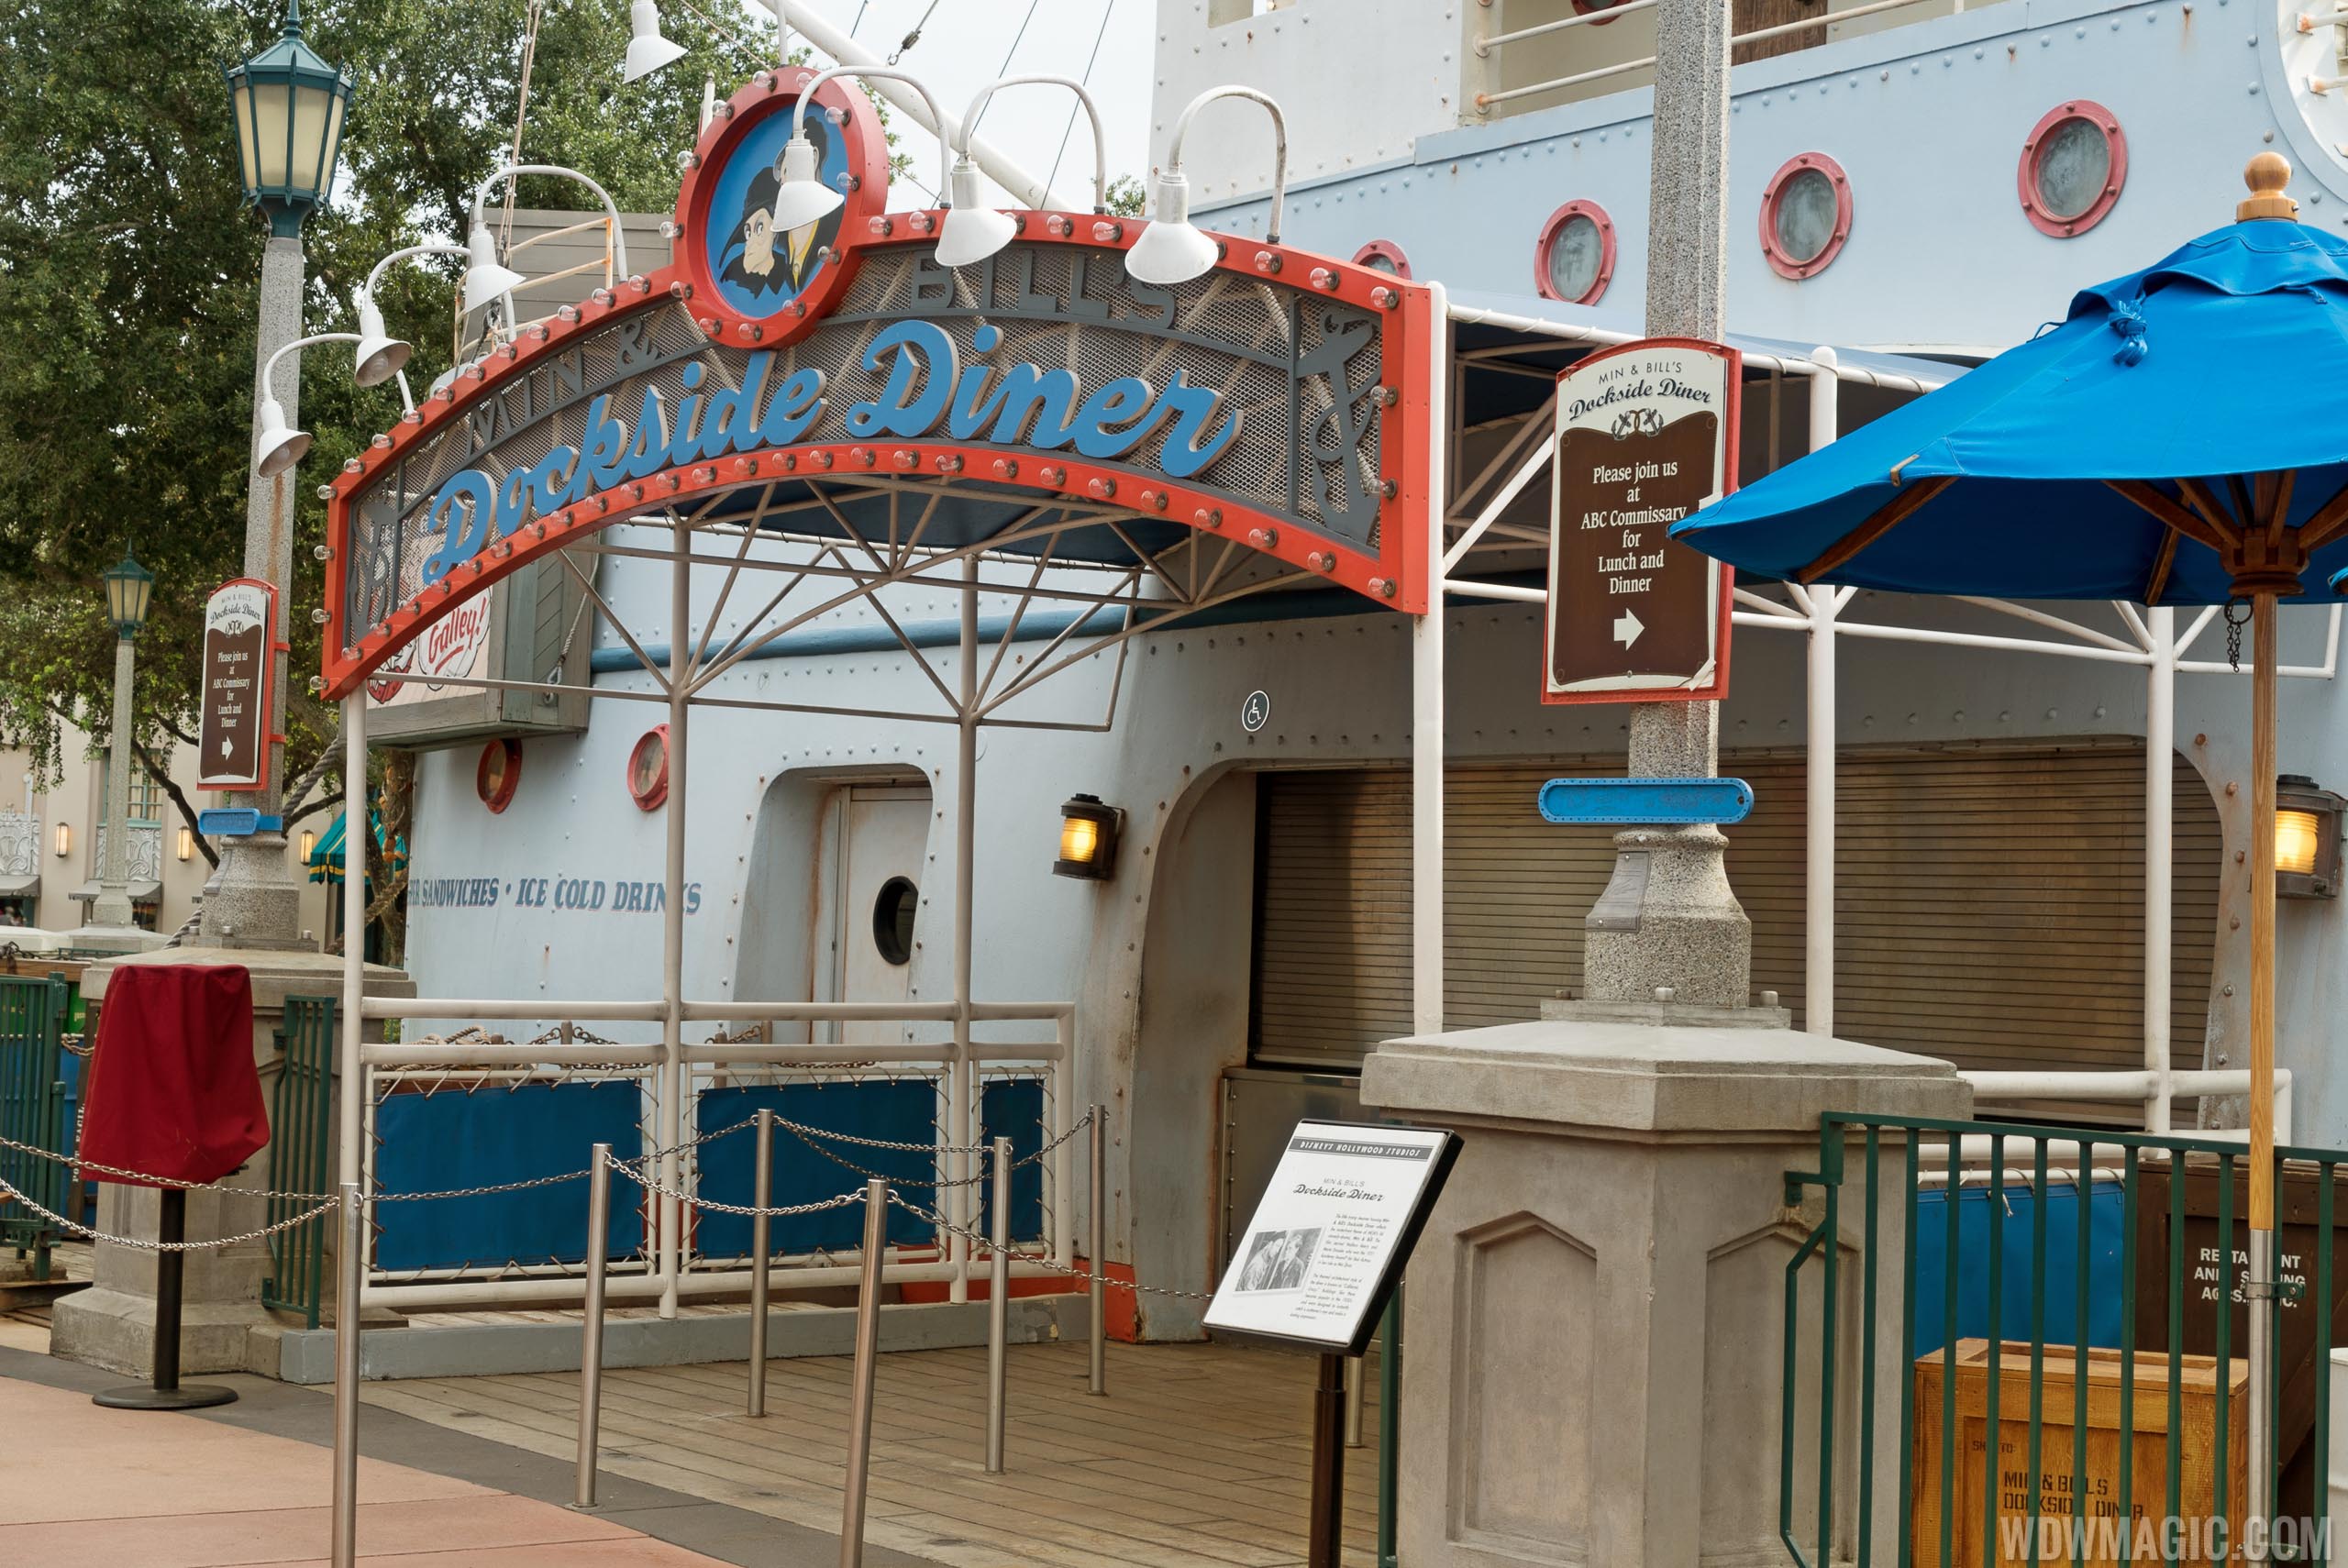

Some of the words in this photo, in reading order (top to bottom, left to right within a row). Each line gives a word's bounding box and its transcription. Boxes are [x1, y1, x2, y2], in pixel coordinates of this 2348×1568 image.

[1599, 368, 1624, 385] MIN
[1631, 365, 1639, 375] &
[1646, 361, 1682, 373] BILL'S
[465, 344, 584, 458] MIN
[615, 317, 661, 375] &
[1569, 379, 1653, 421] Dockside
[1657, 378, 1711, 403] Diner
[423, 350, 829, 587] Dockside
[845, 319, 1244, 479] Diner
[1592, 465, 1633, 484] Please
[1634, 460, 1659, 484] join
[1662, 461, 1678, 477] us
[1626, 486, 1641, 502] at
[1580, 511, 1608, 530] ABC
[1610, 505, 1688, 527] Commissary
[1622, 529, 1642, 548] for
[1598, 552, 1637, 572] Lunch
[1640, 548, 1665, 569] and
[1609, 576, 1652, 594] Dinner
[241, 602, 260, 620] Diner
[428, 596, 488, 665] Galley!
[217, 651, 232, 663] Please
[232, 651, 241, 664] join
[242, 652, 249, 661] us
[213, 678, 223, 690] ABC
[227, 690, 235, 701] for
[217, 703, 232, 715] Lunch
[232, 702, 242, 713] and
[221, 717, 237, 728] Dinner
[422, 878, 500, 907] SANDWICHES
[515, 878, 548, 908] ICE
[554, 878, 606, 911] COLD
[612, 881, 702, 915] DRINS
[1335, 1143, 1384, 1154] HOLLYWOOD
[1386, 1146, 1421, 1157] STUDIOS
[1293, 1184, 1346, 1198] Dockside
[1346, 1188, 1386, 1202] Diner
[2200, 1248, 2301, 1269] RETANT
[2043, 1474, 2054, 1491] &
[2096, 1500, 2143, 1520] DINR
